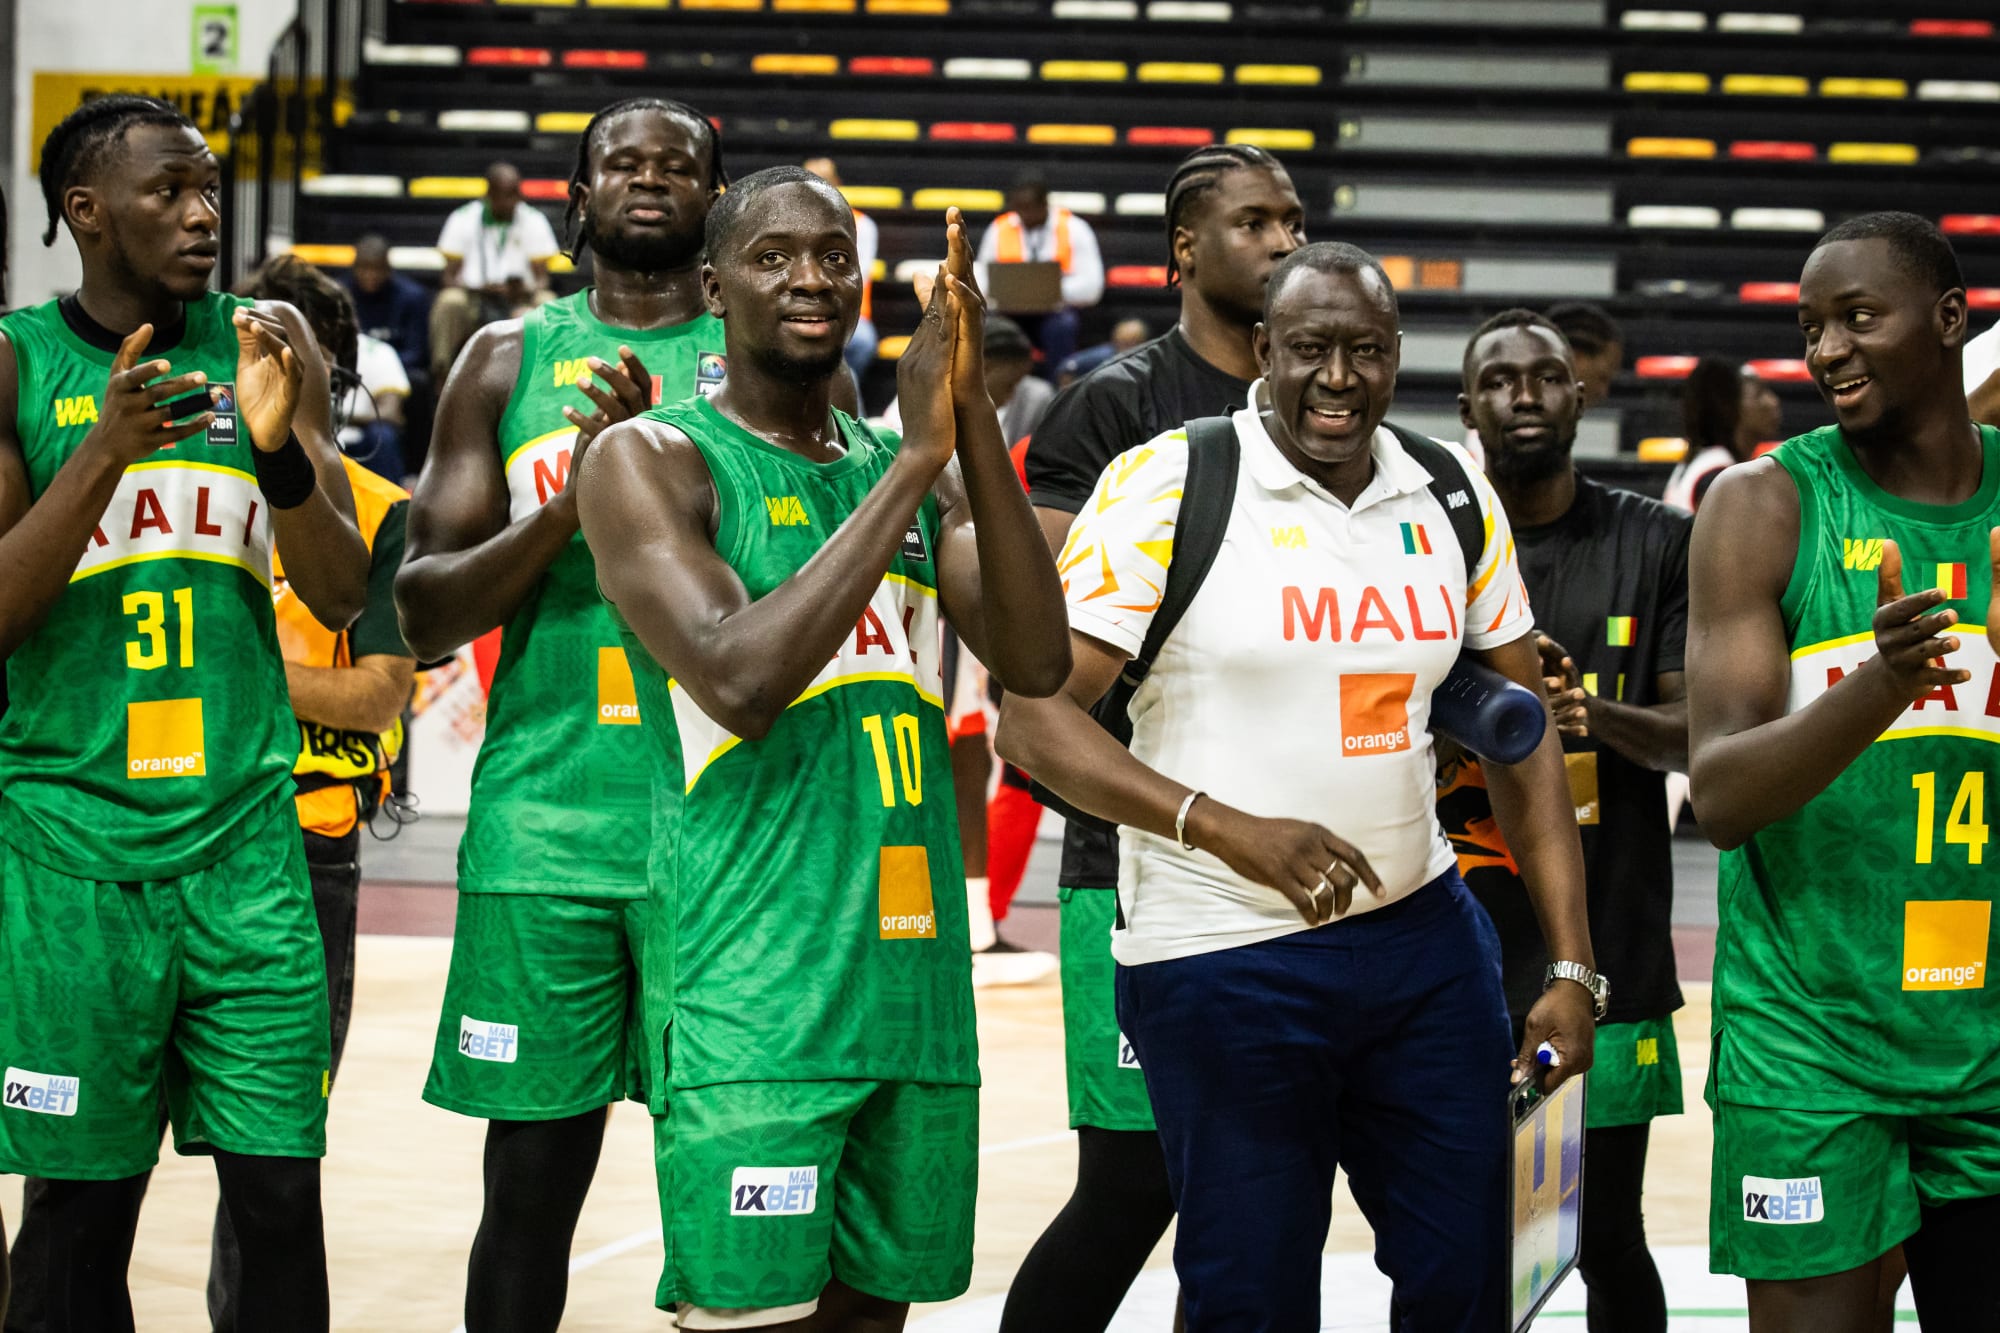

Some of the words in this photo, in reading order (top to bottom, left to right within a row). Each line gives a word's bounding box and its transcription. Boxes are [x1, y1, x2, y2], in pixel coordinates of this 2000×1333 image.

[203, 22, 228, 57] 2
[54, 395, 99, 427] WA
[765, 496, 810, 526] WA
[1446, 490, 1470, 509] WA
[84, 486, 258, 553] ALI
[1271, 525, 1309, 548] WA
[122, 587, 194, 671] 31
[1281, 585, 1458, 643] MALI
[861, 713, 923, 807] 10
[1912, 771, 1989, 864] 14
[489, 1025, 516, 1039] MALI
[6, 1081, 75, 1113] 1XBET
[48, 1077, 77, 1091] MALI
[788, 1168, 816, 1184] MALI
[1786, 1180, 1818, 1195] MALI
[735, 1184, 815, 1211] 1XBET
[1745, 1192, 1819, 1220] 1XBET
